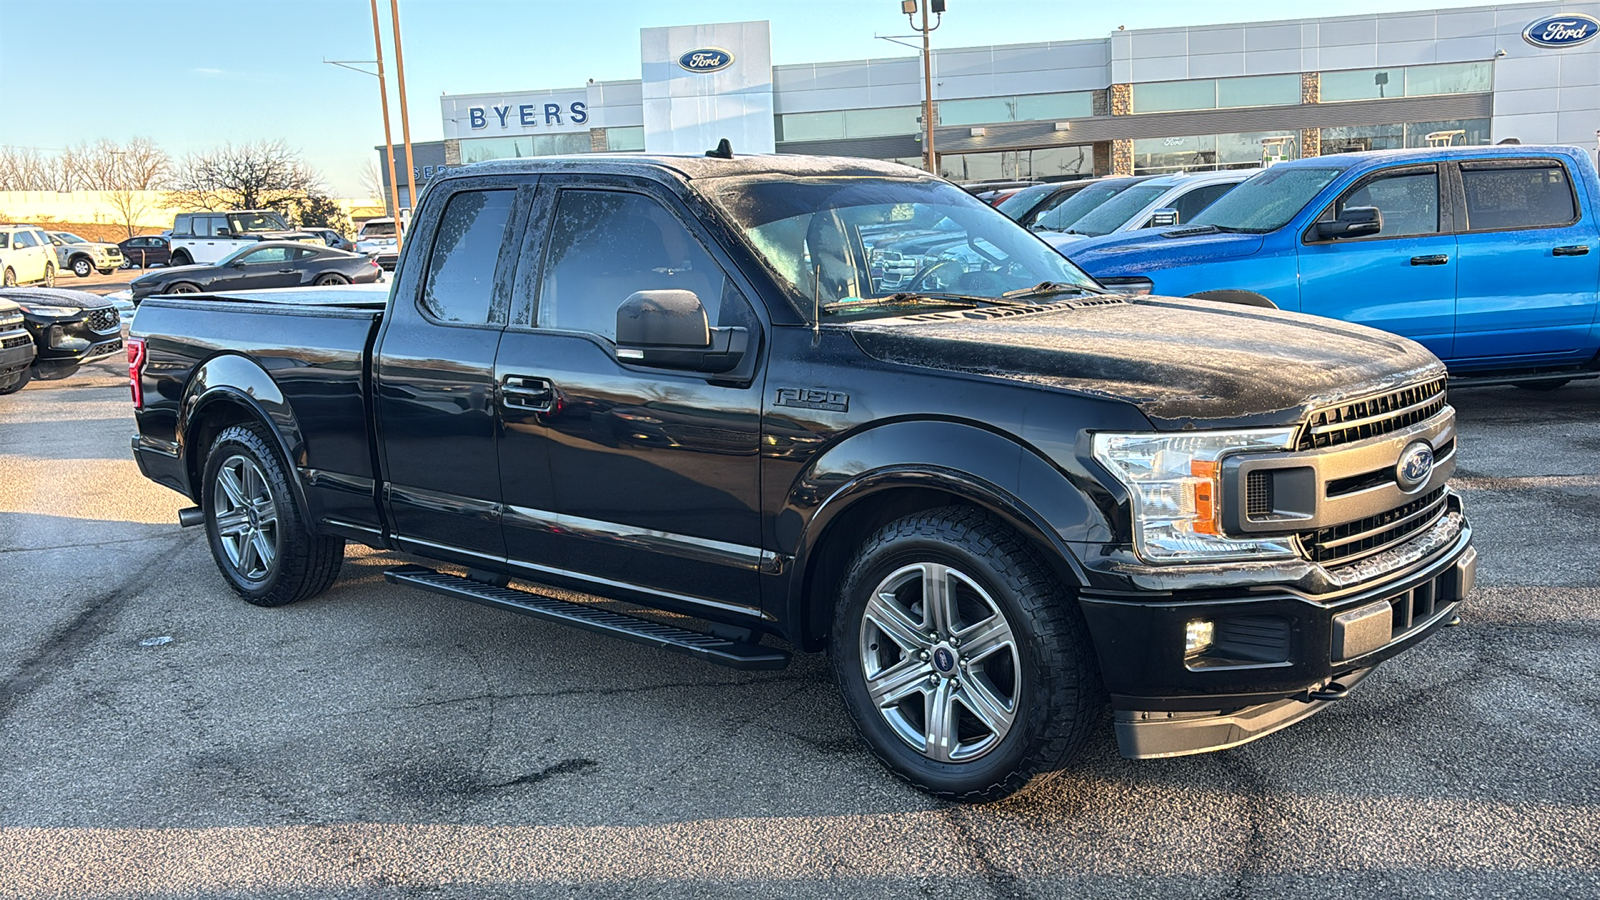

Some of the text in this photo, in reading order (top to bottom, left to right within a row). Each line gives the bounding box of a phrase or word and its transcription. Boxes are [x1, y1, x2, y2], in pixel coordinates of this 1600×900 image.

[1542, 21, 1588, 40] Ford
[690, 52, 720, 67] Ford
[469, 102, 588, 129] BYERS
[1163, 137, 1185, 147] Ford
